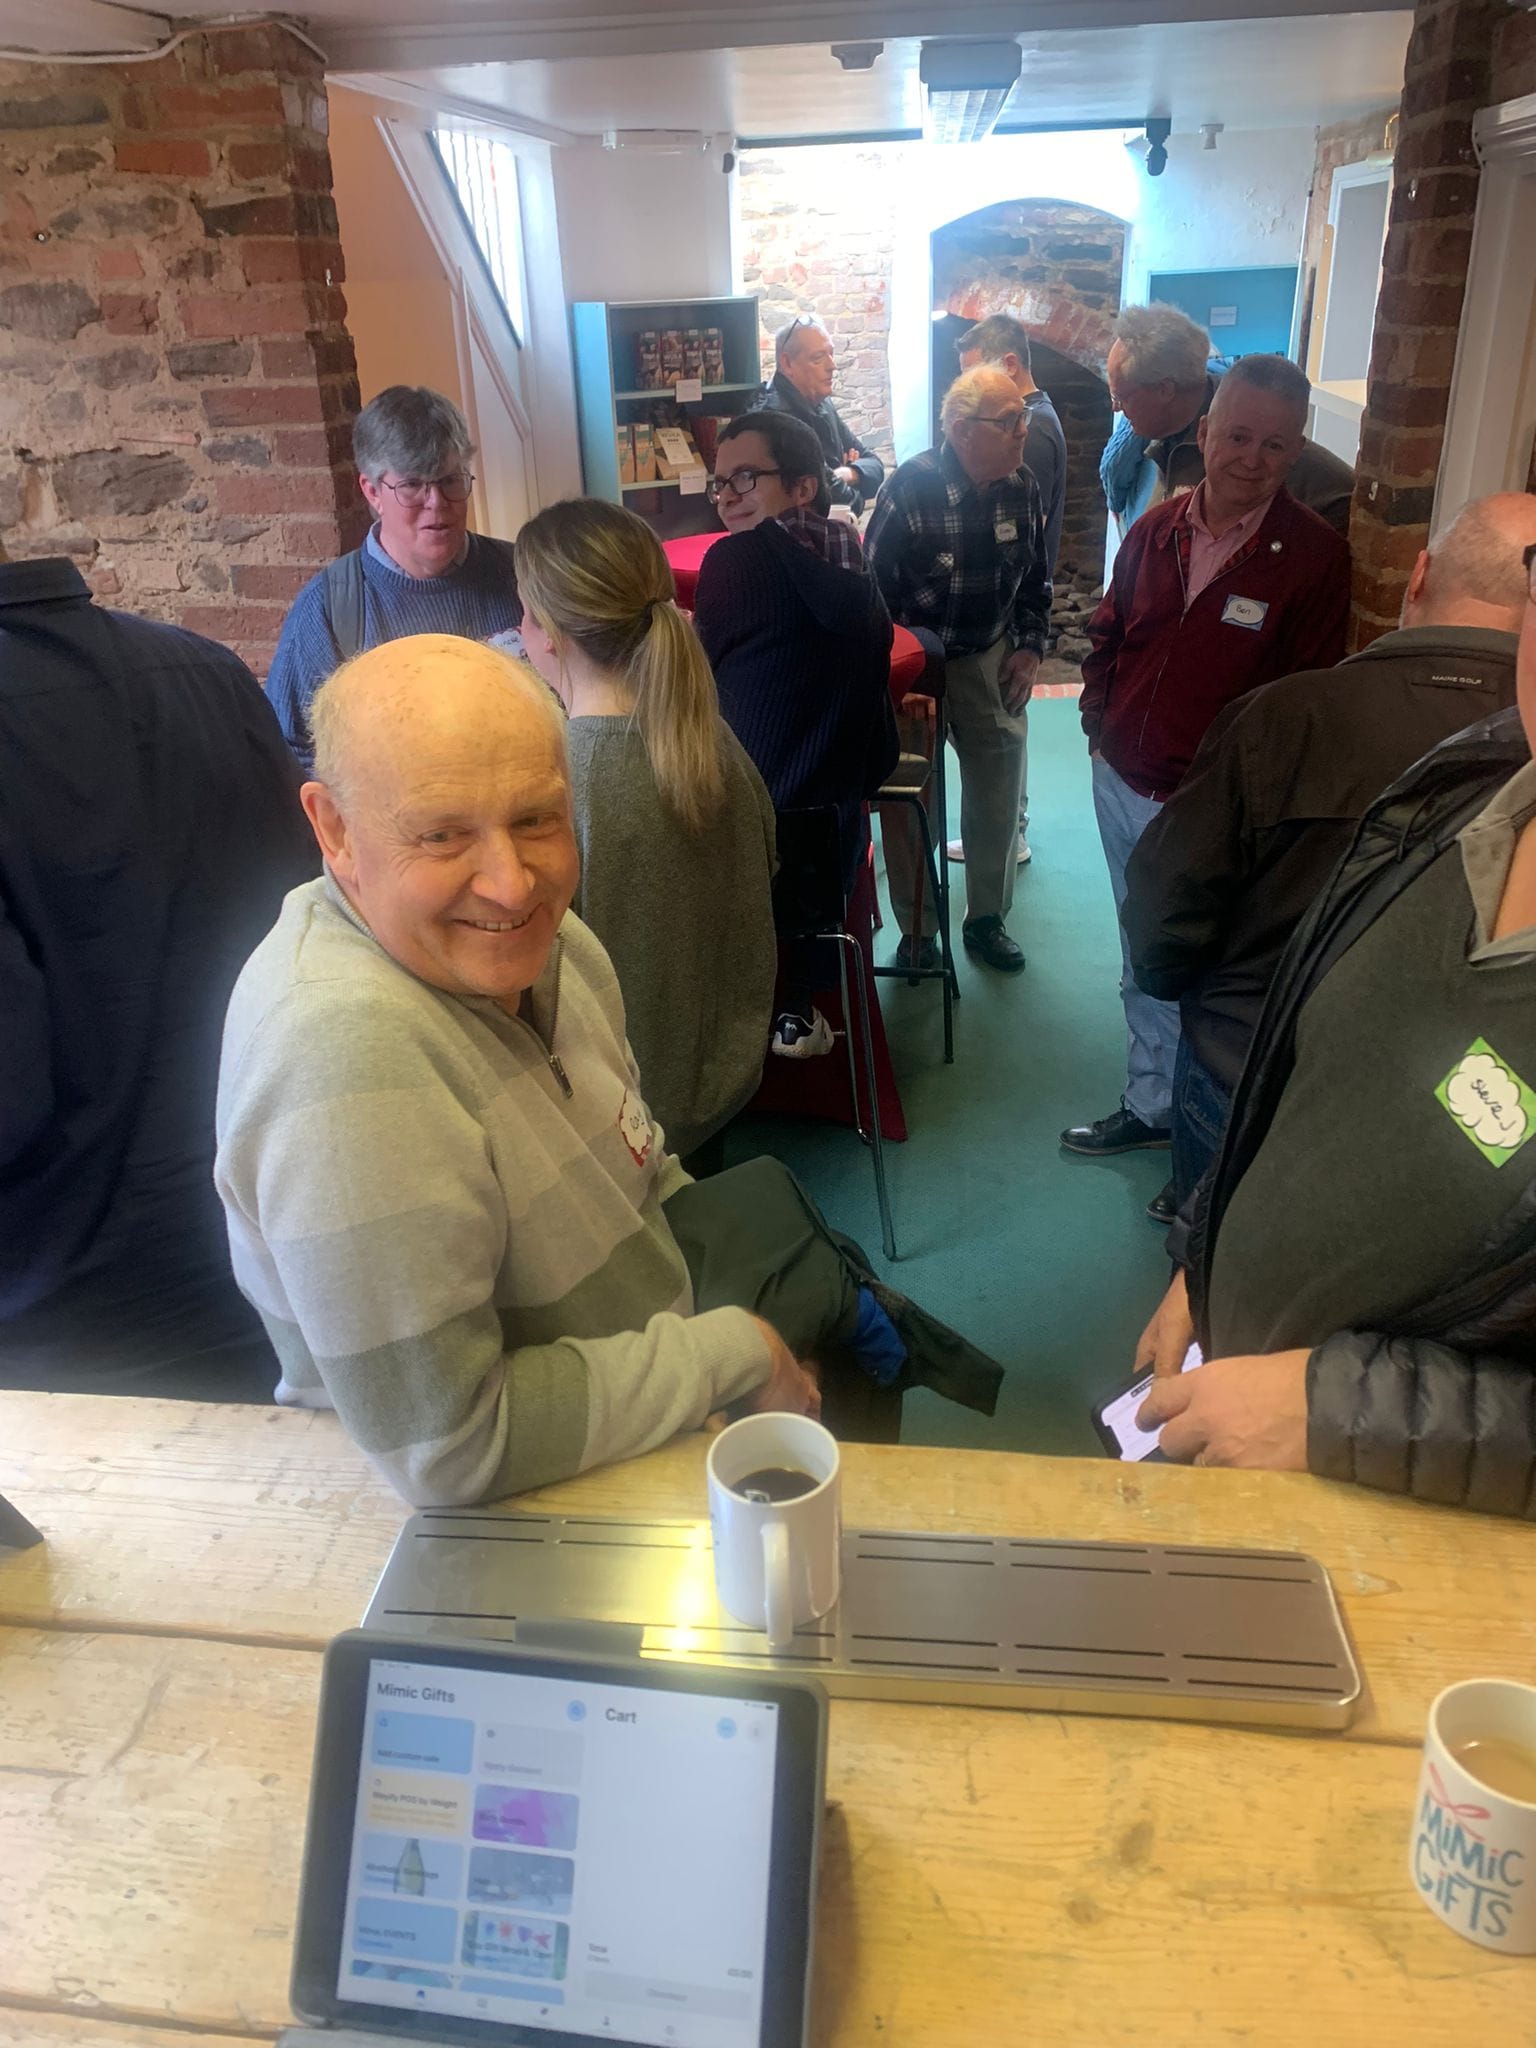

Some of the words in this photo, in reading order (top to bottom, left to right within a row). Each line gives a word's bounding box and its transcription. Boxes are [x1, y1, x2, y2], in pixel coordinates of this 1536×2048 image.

[1236, 604, 1252, 615] Ben
[377, 1682, 418, 1699] Mimic
[421, 1687, 456, 1704] Gifts
[605, 1708, 638, 1724] Cart
